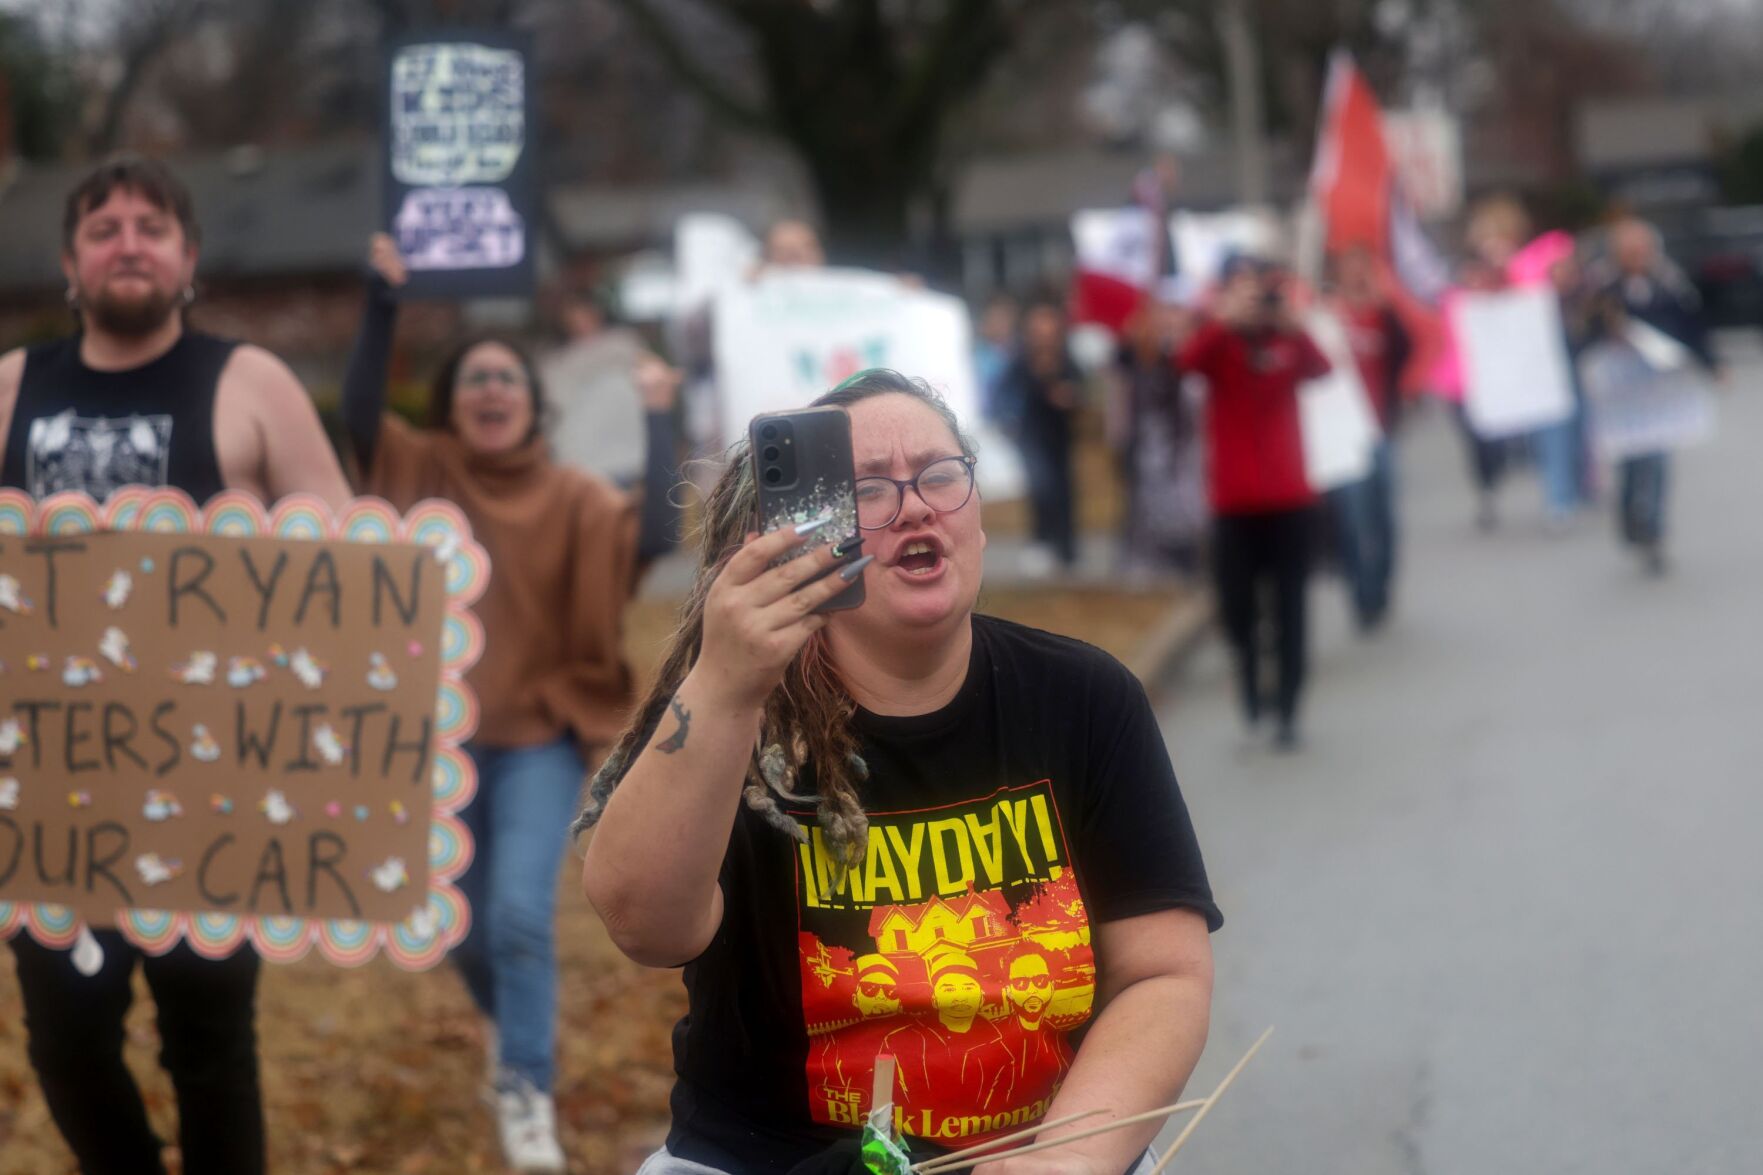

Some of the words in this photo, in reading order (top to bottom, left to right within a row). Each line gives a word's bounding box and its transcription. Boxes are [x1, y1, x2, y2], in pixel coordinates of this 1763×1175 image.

[0, 540, 88, 631] T
[168, 545, 424, 632] RYAN
[0, 699, 181, 778] TERS
[236, 698, 433, 784] WITH
[196, 829, 362, 918] CAR
[823, 1087, 862, 1103] THE
[827, 1100, 916, 1136] Blak
[920, 1083, 1062, 1138] Lemona
